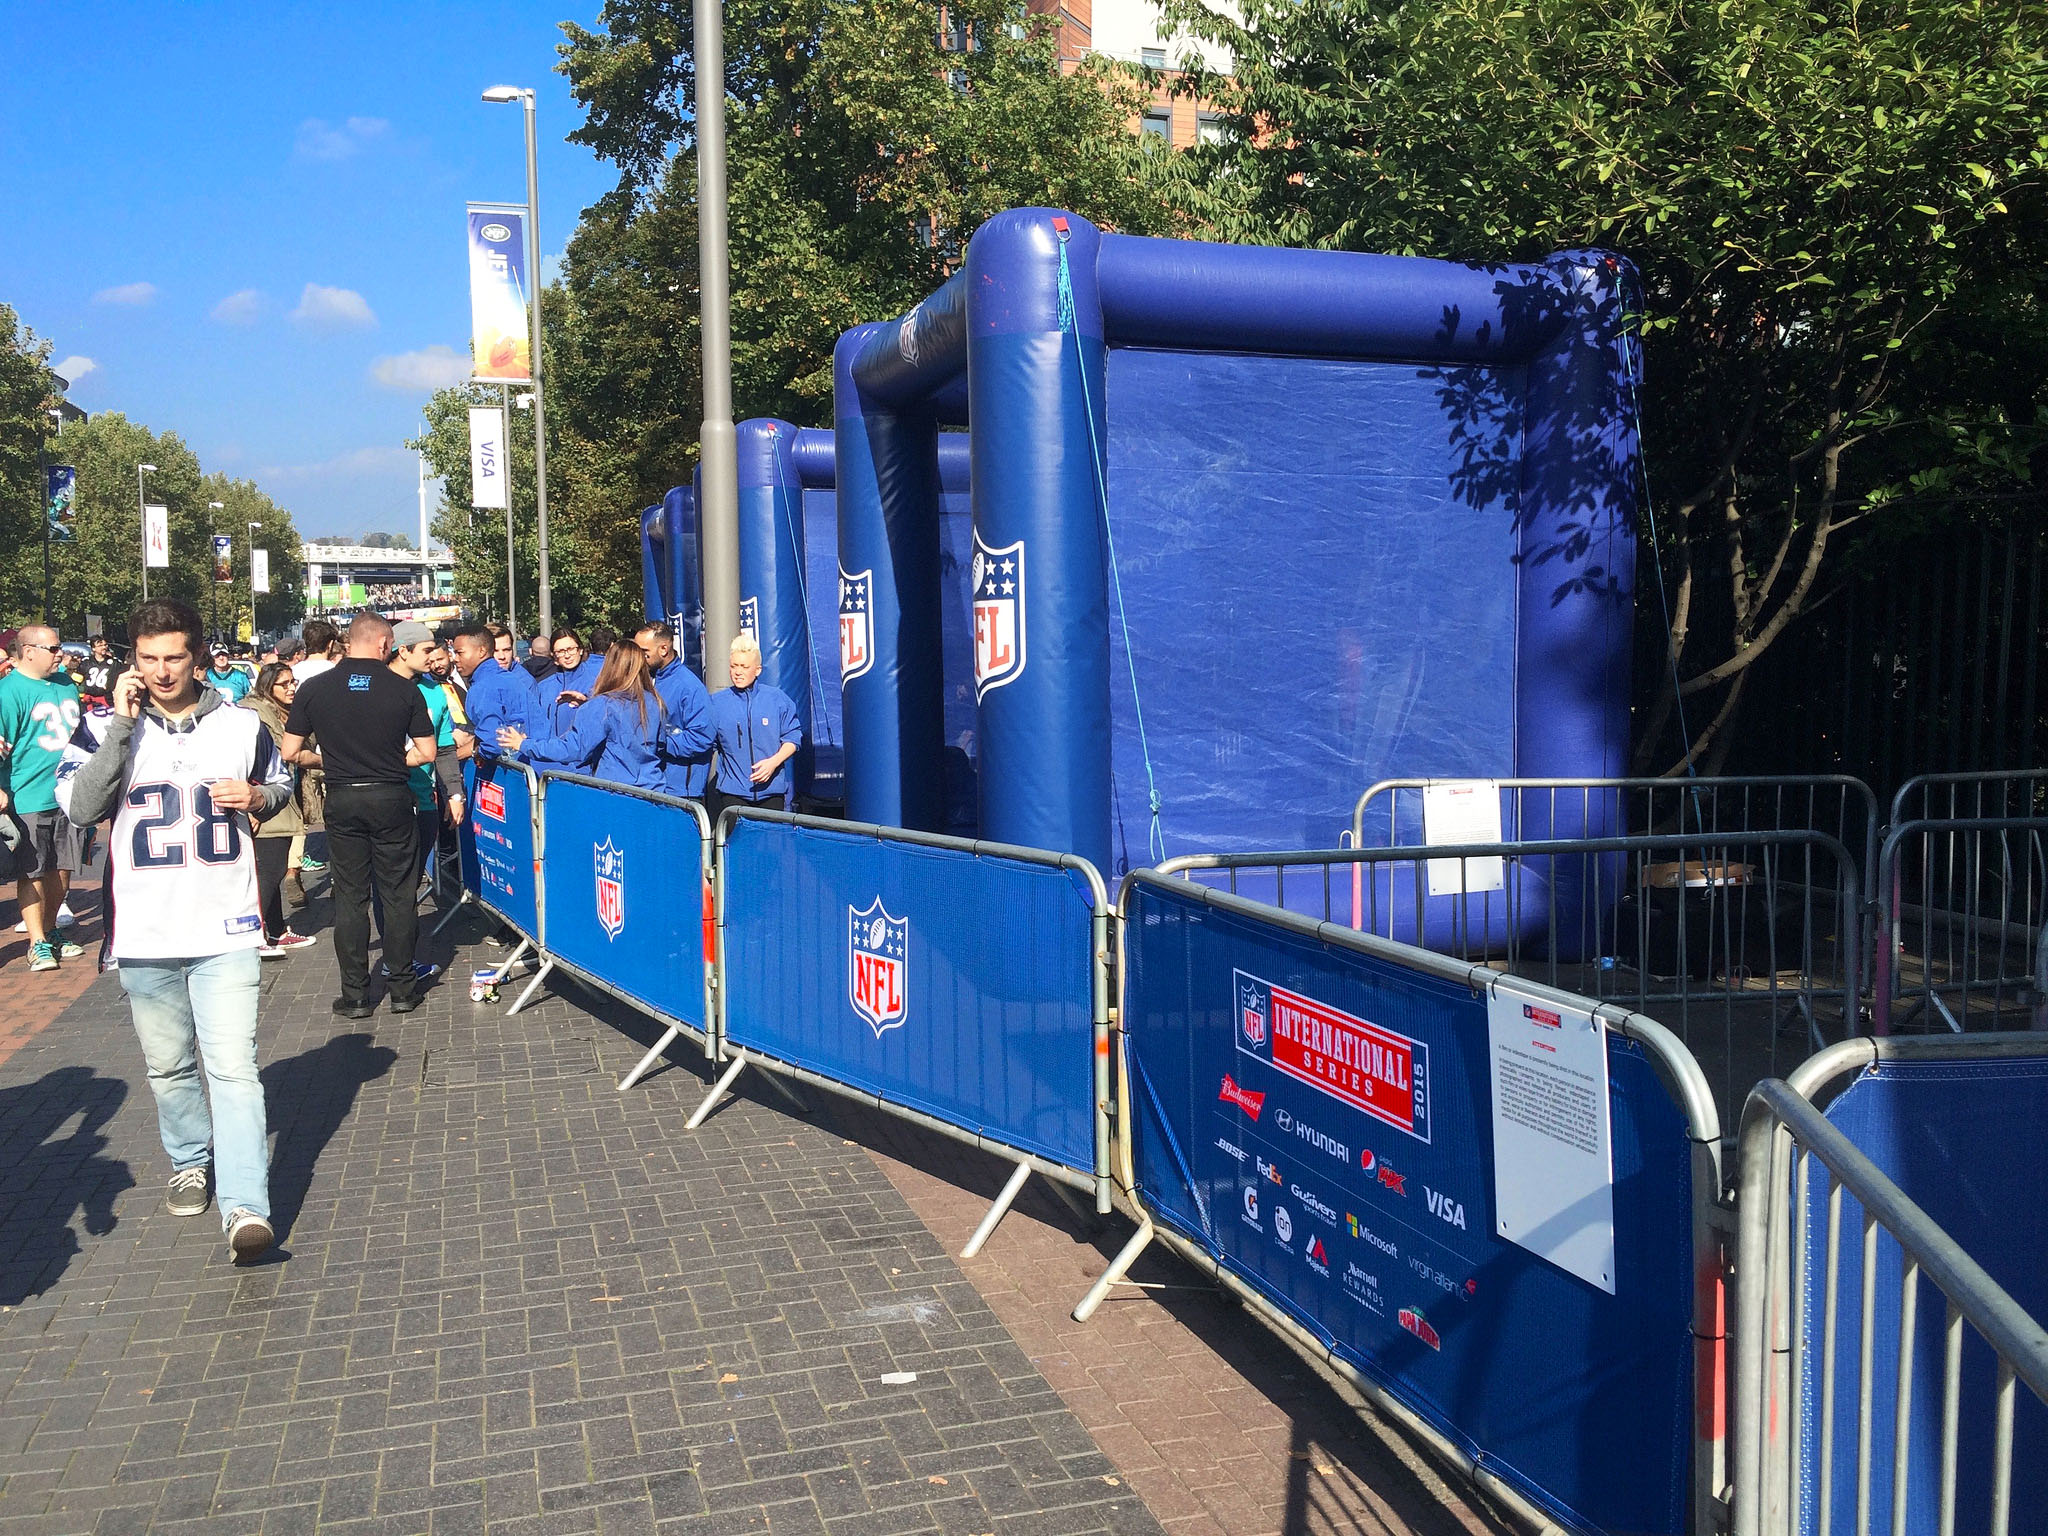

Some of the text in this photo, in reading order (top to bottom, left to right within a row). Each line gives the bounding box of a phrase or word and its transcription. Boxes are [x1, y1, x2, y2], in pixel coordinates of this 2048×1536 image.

[481, 440, 494, 478] VISA
[975, 606, 1009, 678] FL
[86, 667, 109, 688] 36
[127, 778, 243, 871] 28
[600, 880, 620, 925] NFL
[856, 954, 900, 1017] NFL
[1244, 1009, 1264, 1040] NFL
[1274, 1003, 1408, 1091] INTERNATIONAL
[1303, 1051, 1373, 1097] SERIES
[1413, 1063, 1425, 1120] 2015
[1221, 1078, 1261, 1111] Budweiser
[1214, 1138, 1249, 1162] BOSE
[1296, 1120, 1350, 1163] HYUNDAI
[1257, 1155, 1282, 1186] FedEx
[1291, 1184, 1337, 1220] Gullivers
[1422, 1185, 1466, 1231] VISA
[1359, 1224, 1399, 1259] Microsoft
[1343, 1272, 1384, 1306] REWARDS
[1348, 1261, 1377, 1288] Marriott
